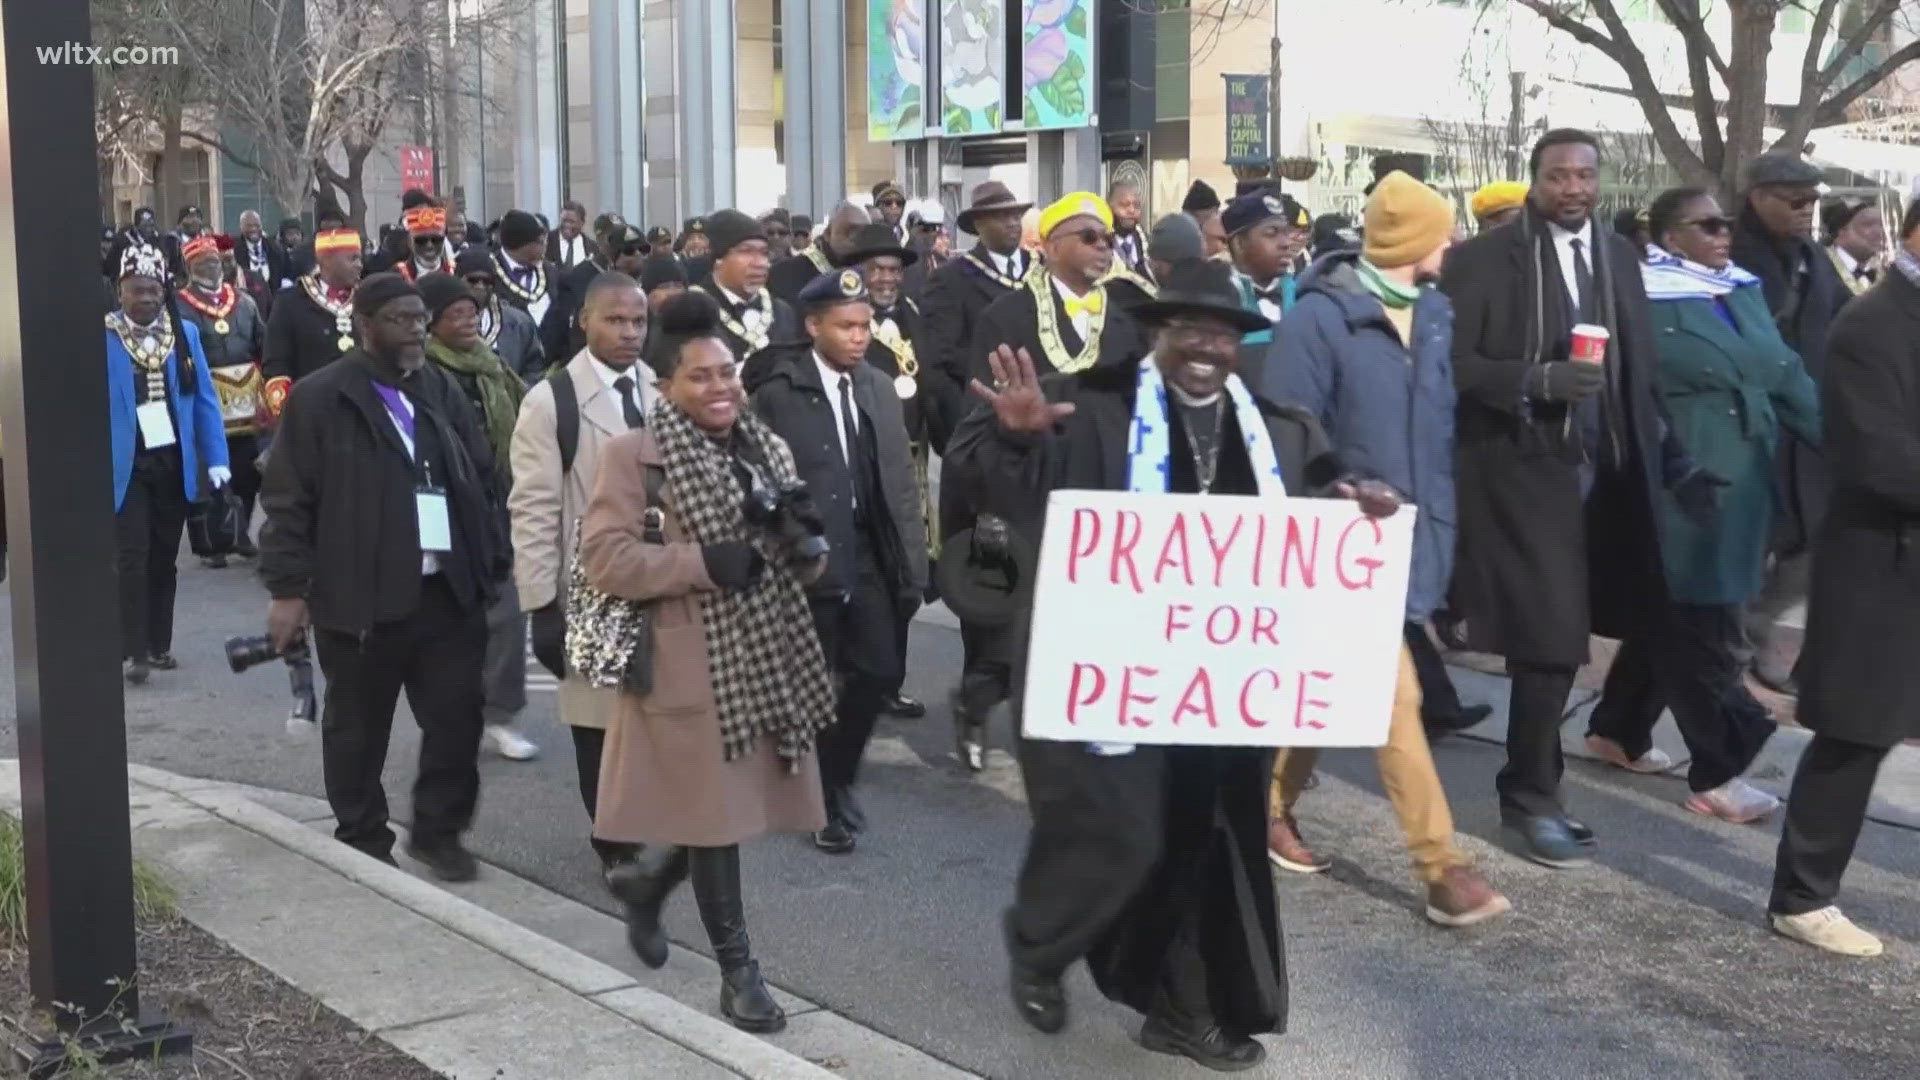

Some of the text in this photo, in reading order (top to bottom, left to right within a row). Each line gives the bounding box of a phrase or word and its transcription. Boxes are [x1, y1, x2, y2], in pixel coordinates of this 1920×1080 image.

[1231, 81, 1247, 97] THE
[1243, 113, 1258, 129] THE
[1231, 128, 1262, 143] CAPITAL
[1231, 143, 1249, 158] CITY
[1067, 507, 1385, 594] PRAYING
[1164, 603, 1280, 646] FOR
[1066, 661, 1334, 730] PEACE
